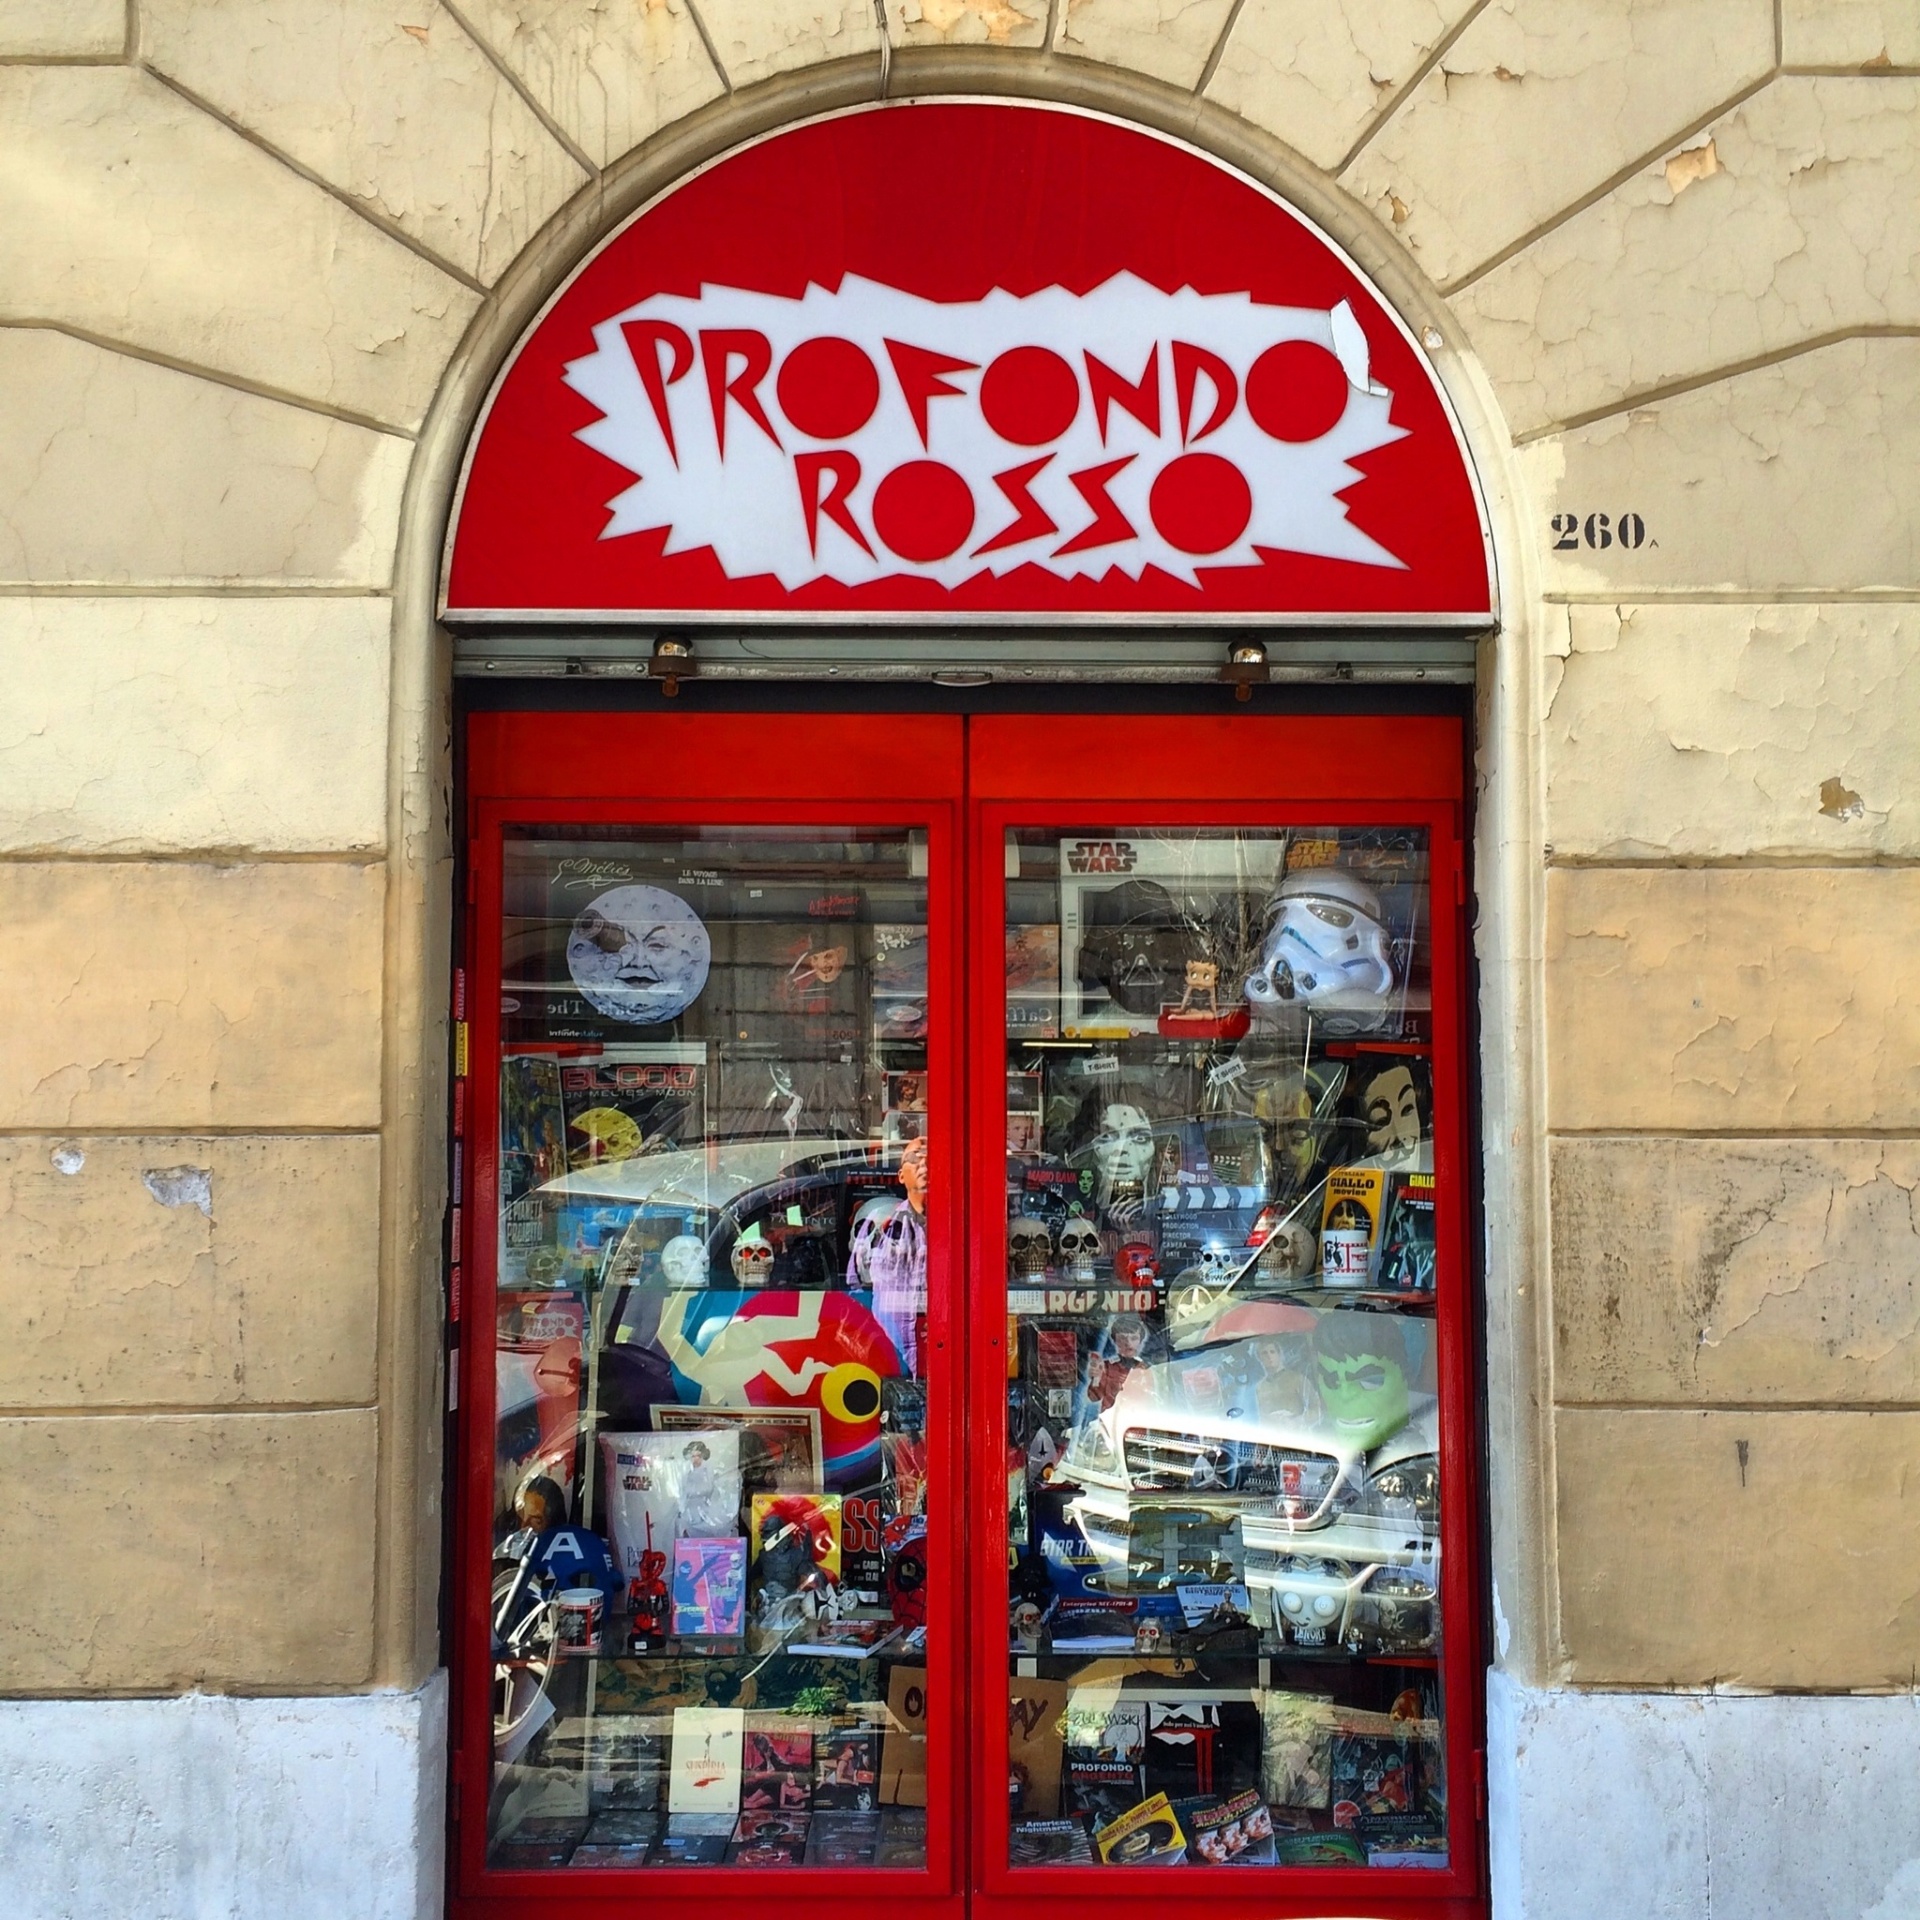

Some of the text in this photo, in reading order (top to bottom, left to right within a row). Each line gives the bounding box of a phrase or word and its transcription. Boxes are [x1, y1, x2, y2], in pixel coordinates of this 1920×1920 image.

[619, 319, 1348, 470] PROFONDO
[793, 449, 1252, 562] ROSSO
[1068, 842, 1137, 857] STAR
[1068, 857, 1137, 873] WARS
[1087, 1061, 1117, 1072] T-SHIRT
[1214, 1063, 1242, 1080] T-SHIRT
[562, 1065, 698, 1091] BLOOD
[1055, 1171, 1078, 1183] BAVA
[1330, 1177, 1375, 1190] GIALLO
[1333, 1187, 1367, 1196] movies
[1162, 1241, 1187, 1249] CAMERA
[1048, 1290, 1152, 1314] RGENTO
[1040, 1539, 1074, 1557] STAR
[1071, 1762, 1133, 1772] PROFONDO
[1015, 1825, 1074, 1835] Nightmares
[1025, 1819, 1073, 1829] American
